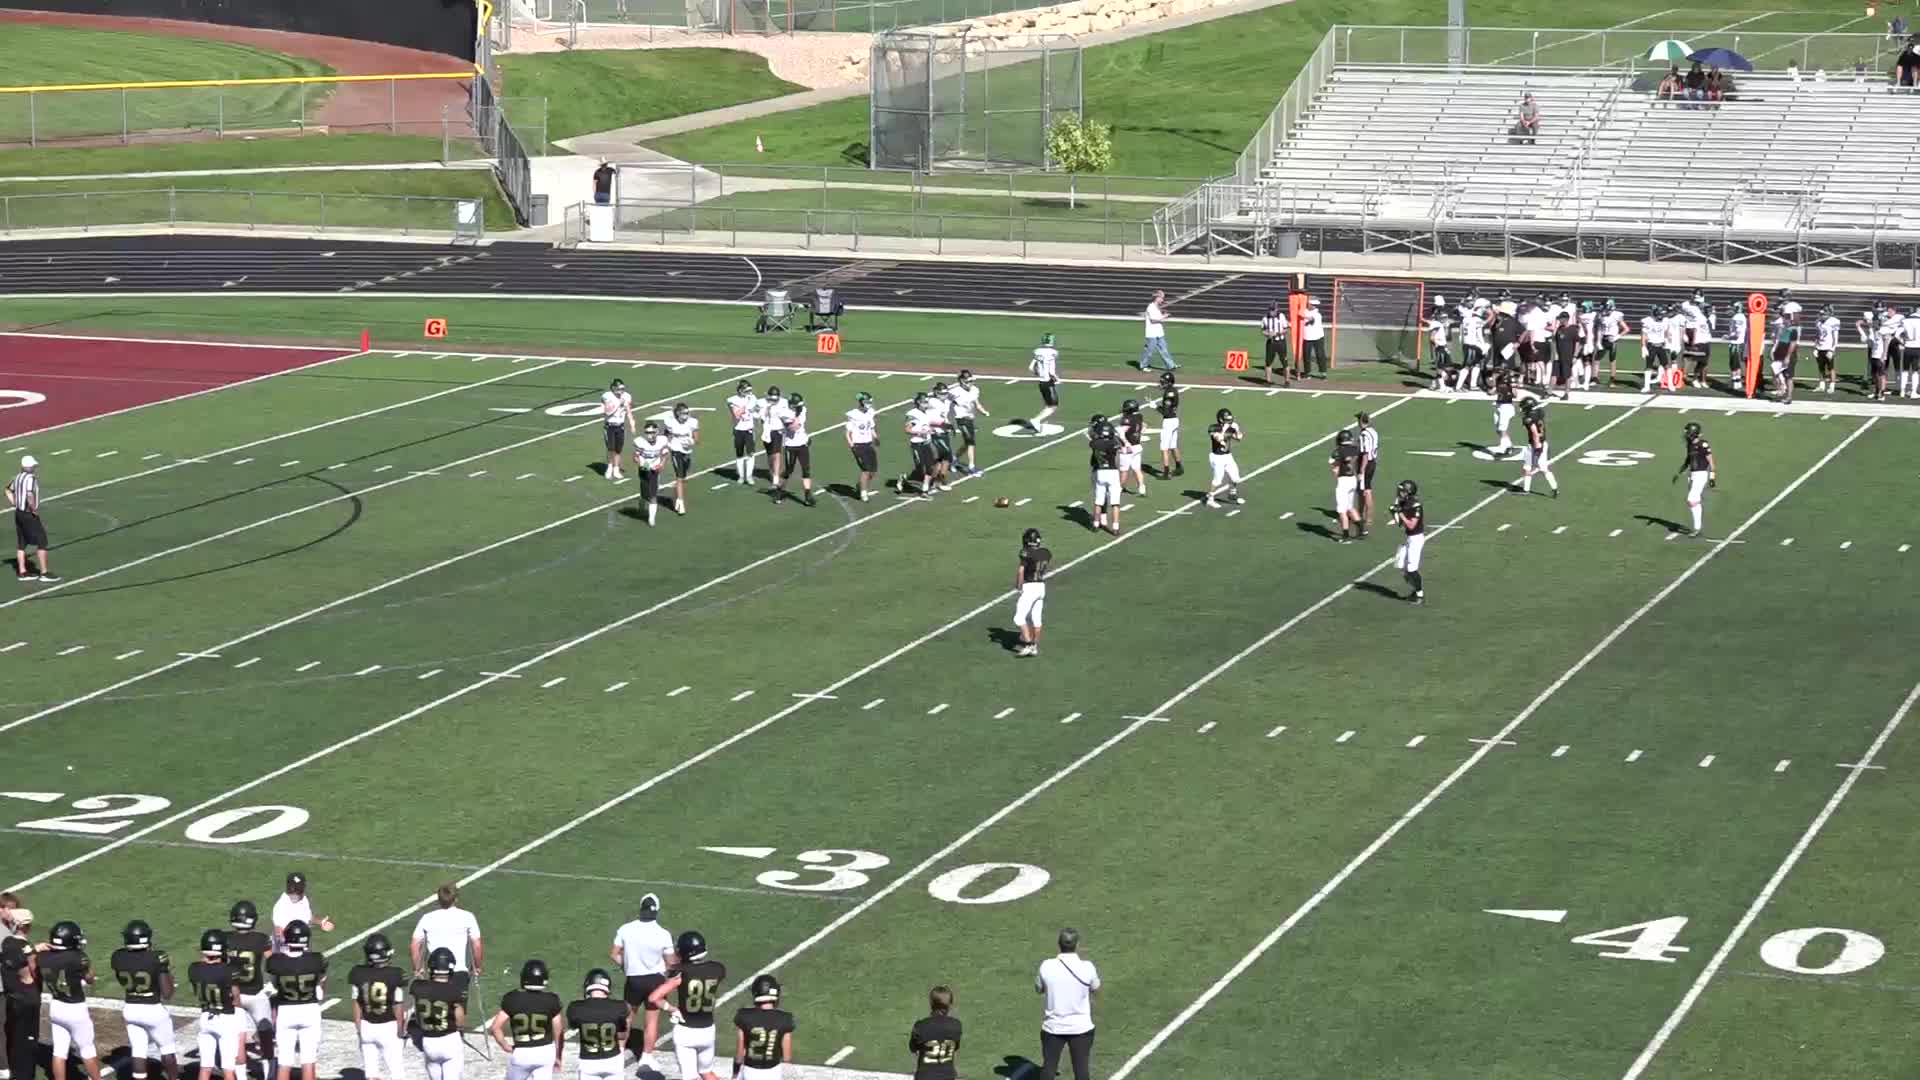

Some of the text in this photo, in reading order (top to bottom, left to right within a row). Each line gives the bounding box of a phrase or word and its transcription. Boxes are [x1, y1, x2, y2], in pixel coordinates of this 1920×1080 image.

[427, 320, 441, 336] G
[821, 335, 835, 351] 10
[1228, 353, 1244, 369] 20
[281, 973, 317, 1001] 55
[685, 978, 719, 1014] 85
[419, 998, 449, 1032] 23
[512, 1012, 549, 1043] 25
[748, 1026, 778, 1061] 21
